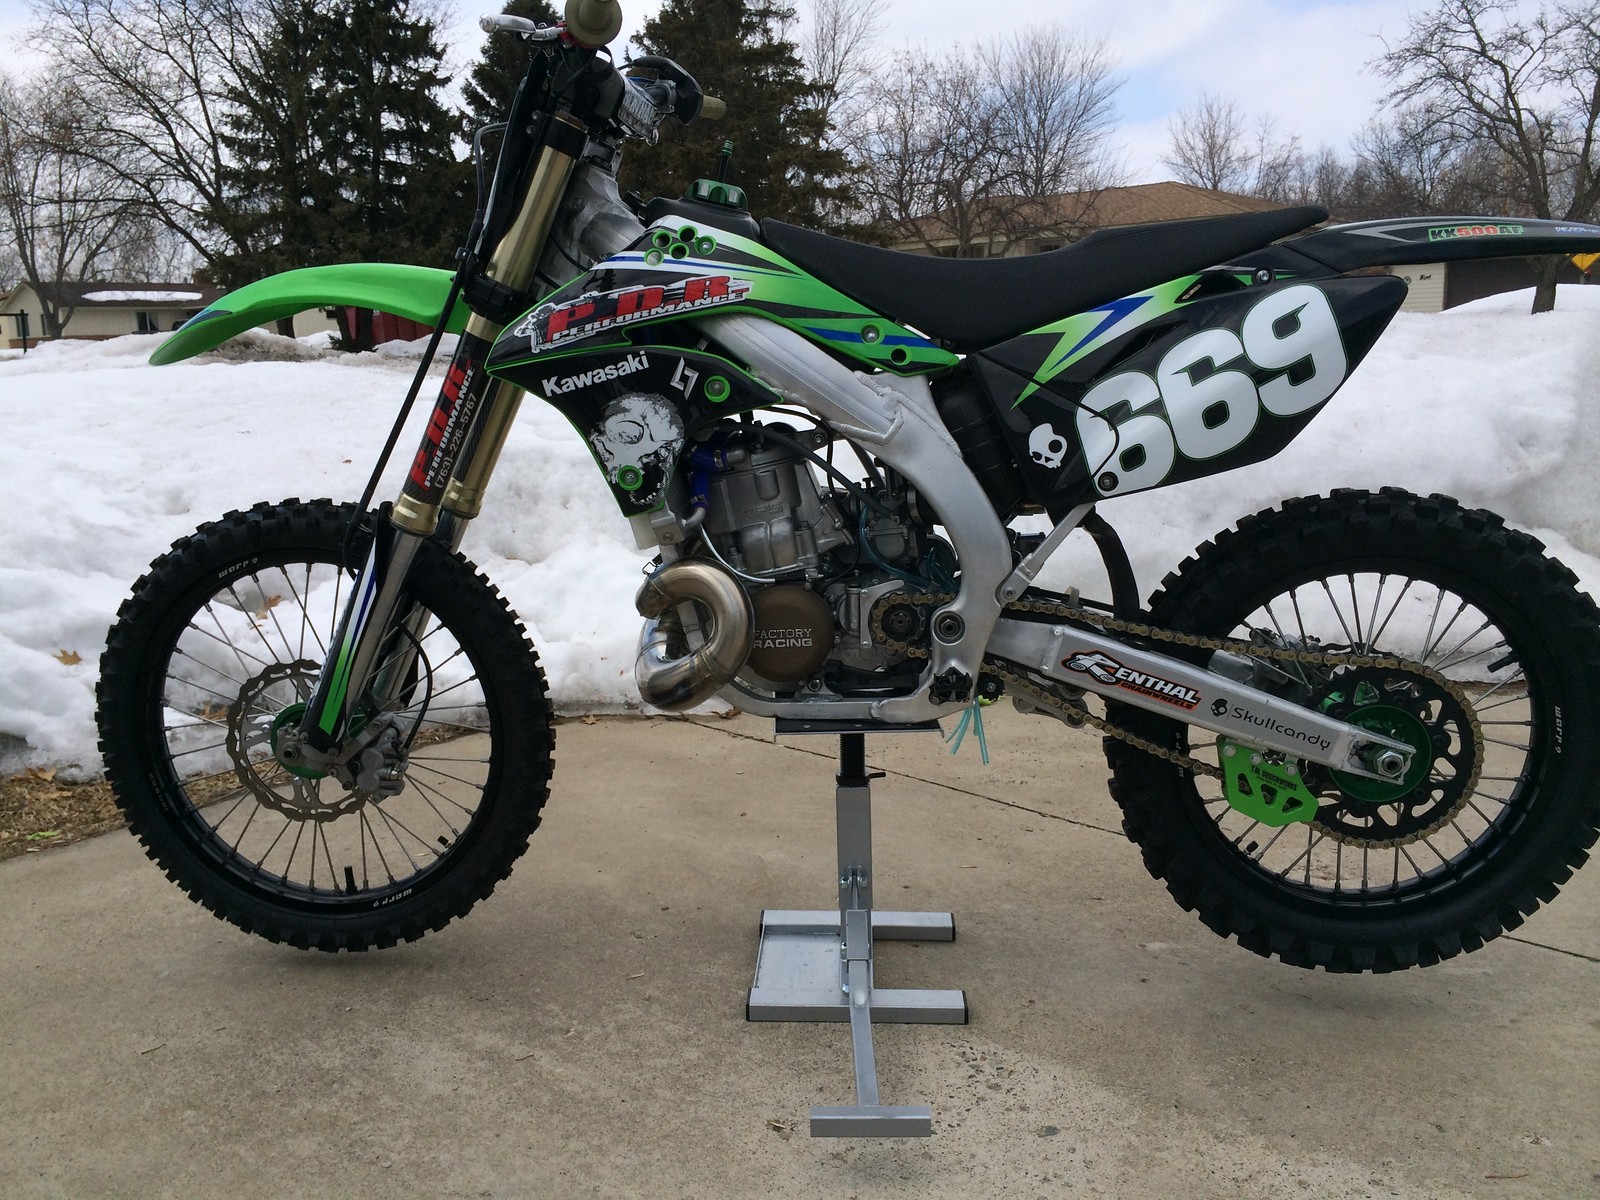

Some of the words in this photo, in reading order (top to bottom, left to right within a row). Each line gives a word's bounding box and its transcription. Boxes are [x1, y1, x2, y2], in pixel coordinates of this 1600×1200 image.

[1430, 224, 1523, 240] KX500AF
[551, 290, 747, 341] PERFORMANCE
[541, 350, 650, 397] Kawasaki
[1075, 283, 1348, 497] 669
[424, 364, 476, 488] PERFORMANCE
[753, 638, 813, 649] RACING
[755, 628, 812, 639] FACTORY
[1066, 652, 1200, 704] RENTHAL
[1120, 682, 1194, 710] CHAINWHEELS
[1231, 706, 1331, 751] Skullcandy
